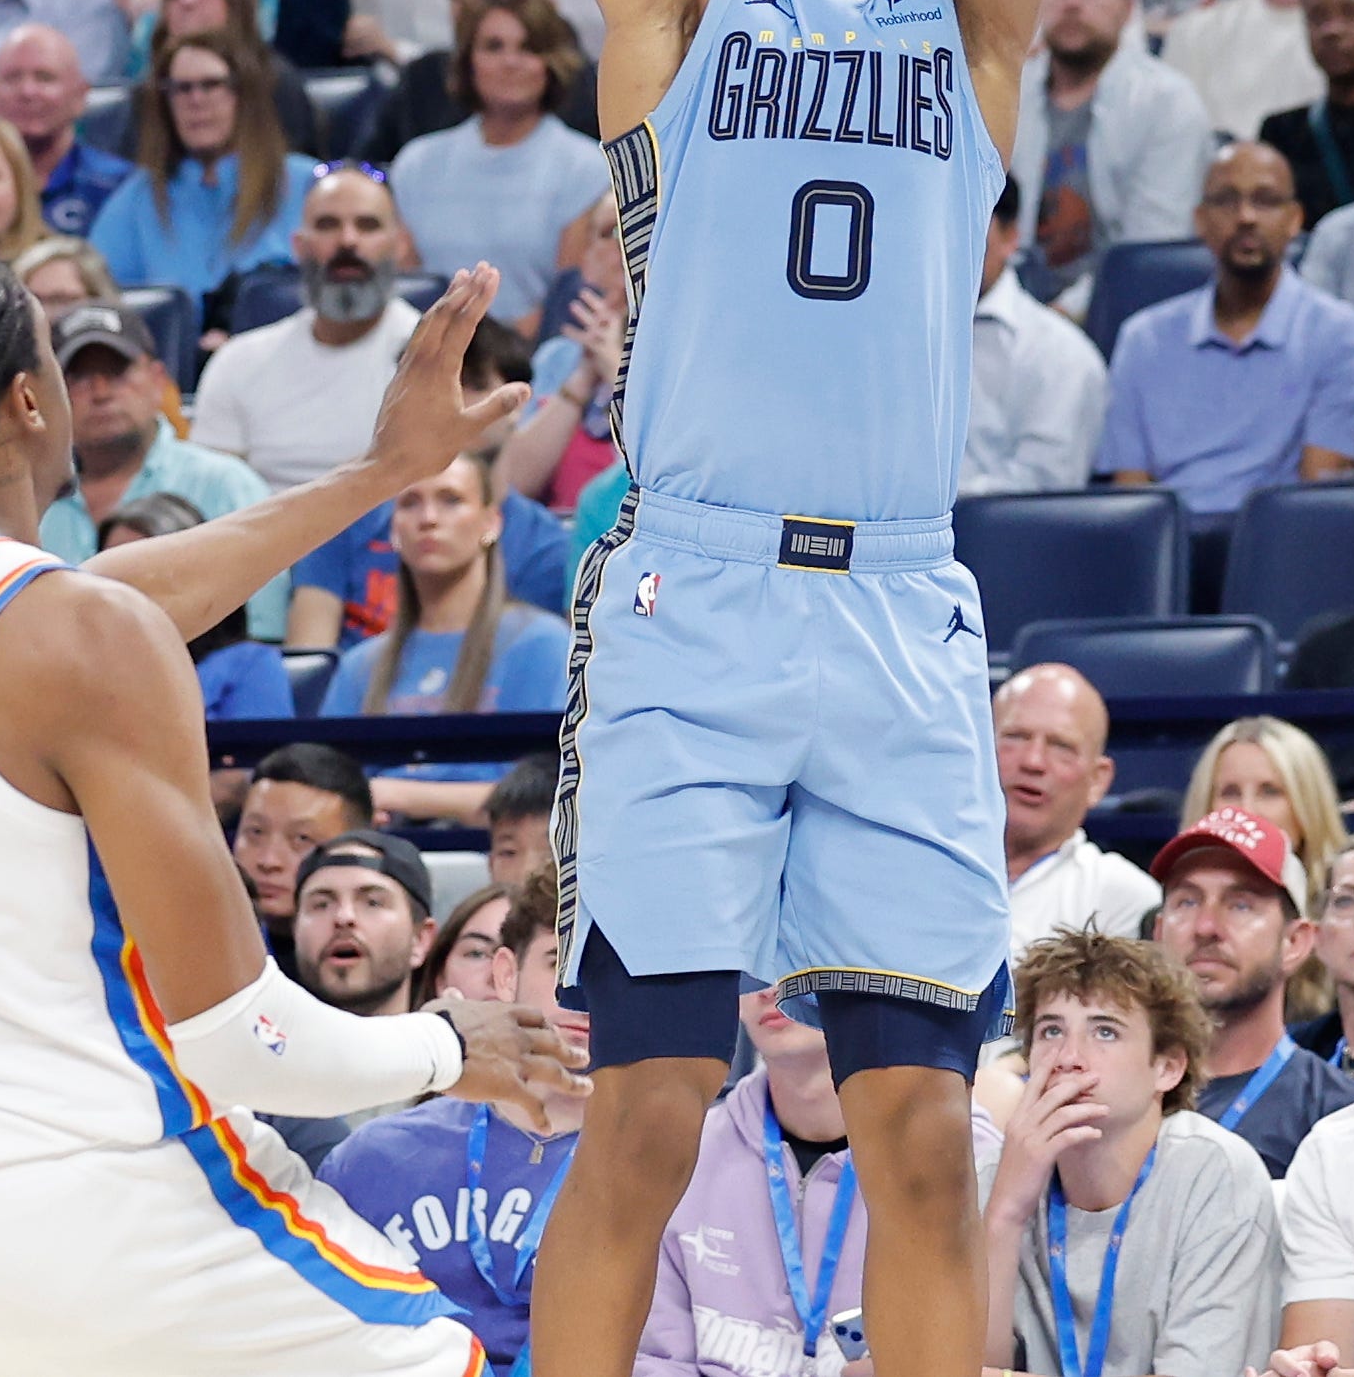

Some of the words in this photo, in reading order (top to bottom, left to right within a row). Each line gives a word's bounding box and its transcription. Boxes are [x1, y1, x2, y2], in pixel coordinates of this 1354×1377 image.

[758, 30, 933, 54] MEMPIS
[875, 7, 943, 27] Robinhood
[708, 30, 953, 161] GRIZZLIES
[786, 179, 874, 301] 0
[383, 1187, 534, 1268] FORG
